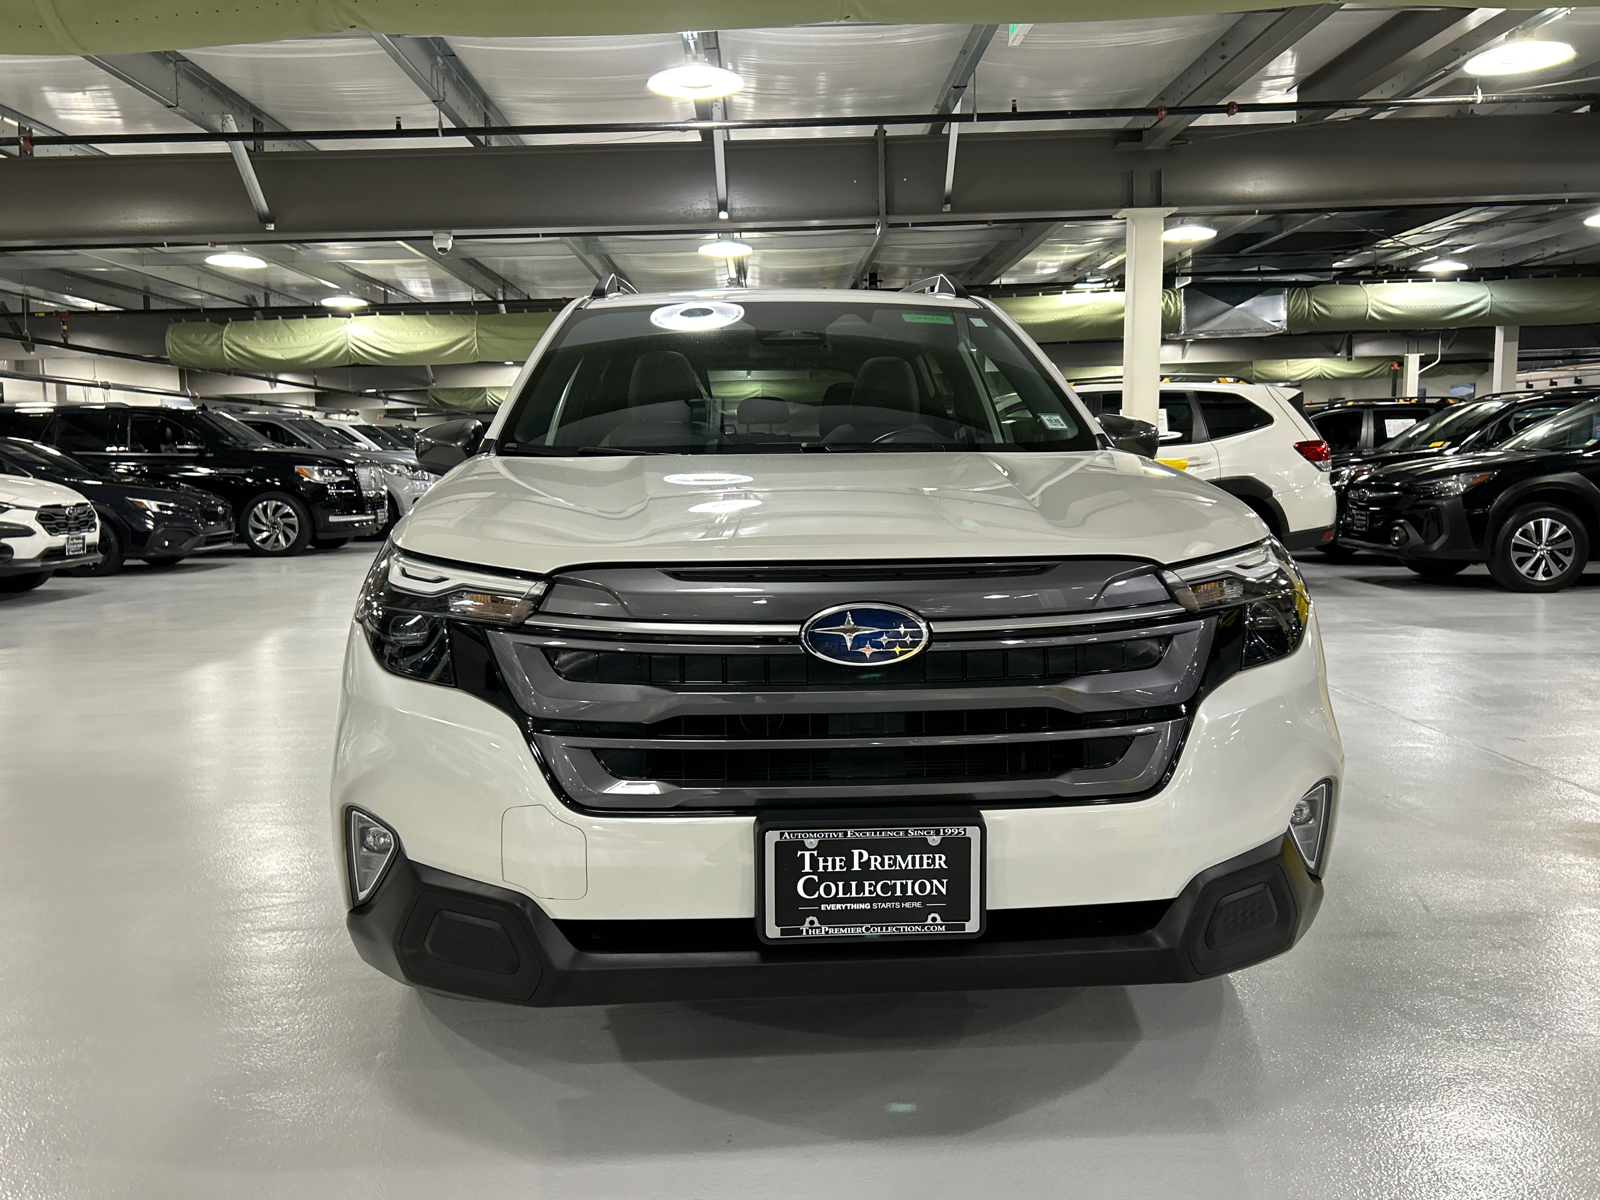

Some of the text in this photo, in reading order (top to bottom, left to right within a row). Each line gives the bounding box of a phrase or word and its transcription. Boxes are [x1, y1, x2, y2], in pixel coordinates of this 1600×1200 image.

[781, 827, 965, 840] AUTOMOTIVE EXCELLENCE SINCE 1995
[797, 849, 948, 873] THE PREMIER
[796, 875, 948, 899] COLLECTION
[821, 903, 870, 911] EVERYTHING
[901, 901, 924, 909] HERE.
